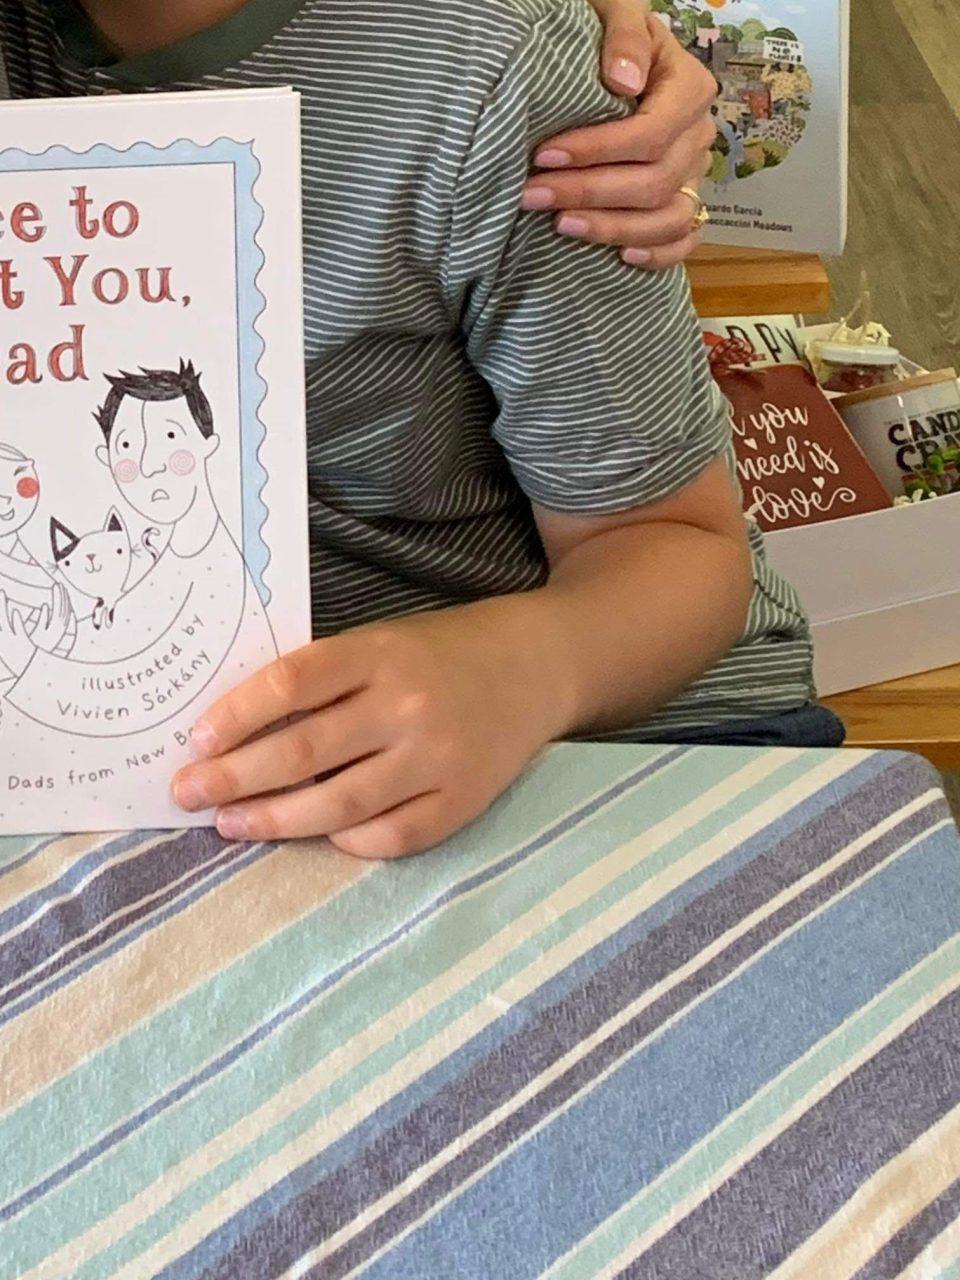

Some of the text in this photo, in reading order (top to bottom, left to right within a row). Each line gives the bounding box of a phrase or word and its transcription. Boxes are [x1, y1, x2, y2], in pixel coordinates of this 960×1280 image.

[69, 185, 139, 239] to
[753, 220, 793, 232] Meadows
[43, 254, 191, 307] You,
[750, 402, 809, 444] you
[888, 409, 960, 445] CAND
[737, 436, 840, 480] need is
[748, 485, 856, 523] love
[81, 613, 206, 691] illustrated by
[56, 649, 212, 721] Vivien Sárkány
[8, 775, 55, 791] Dads
[68, 768, 115, 785] from
[125, 745, 166, 769] New
